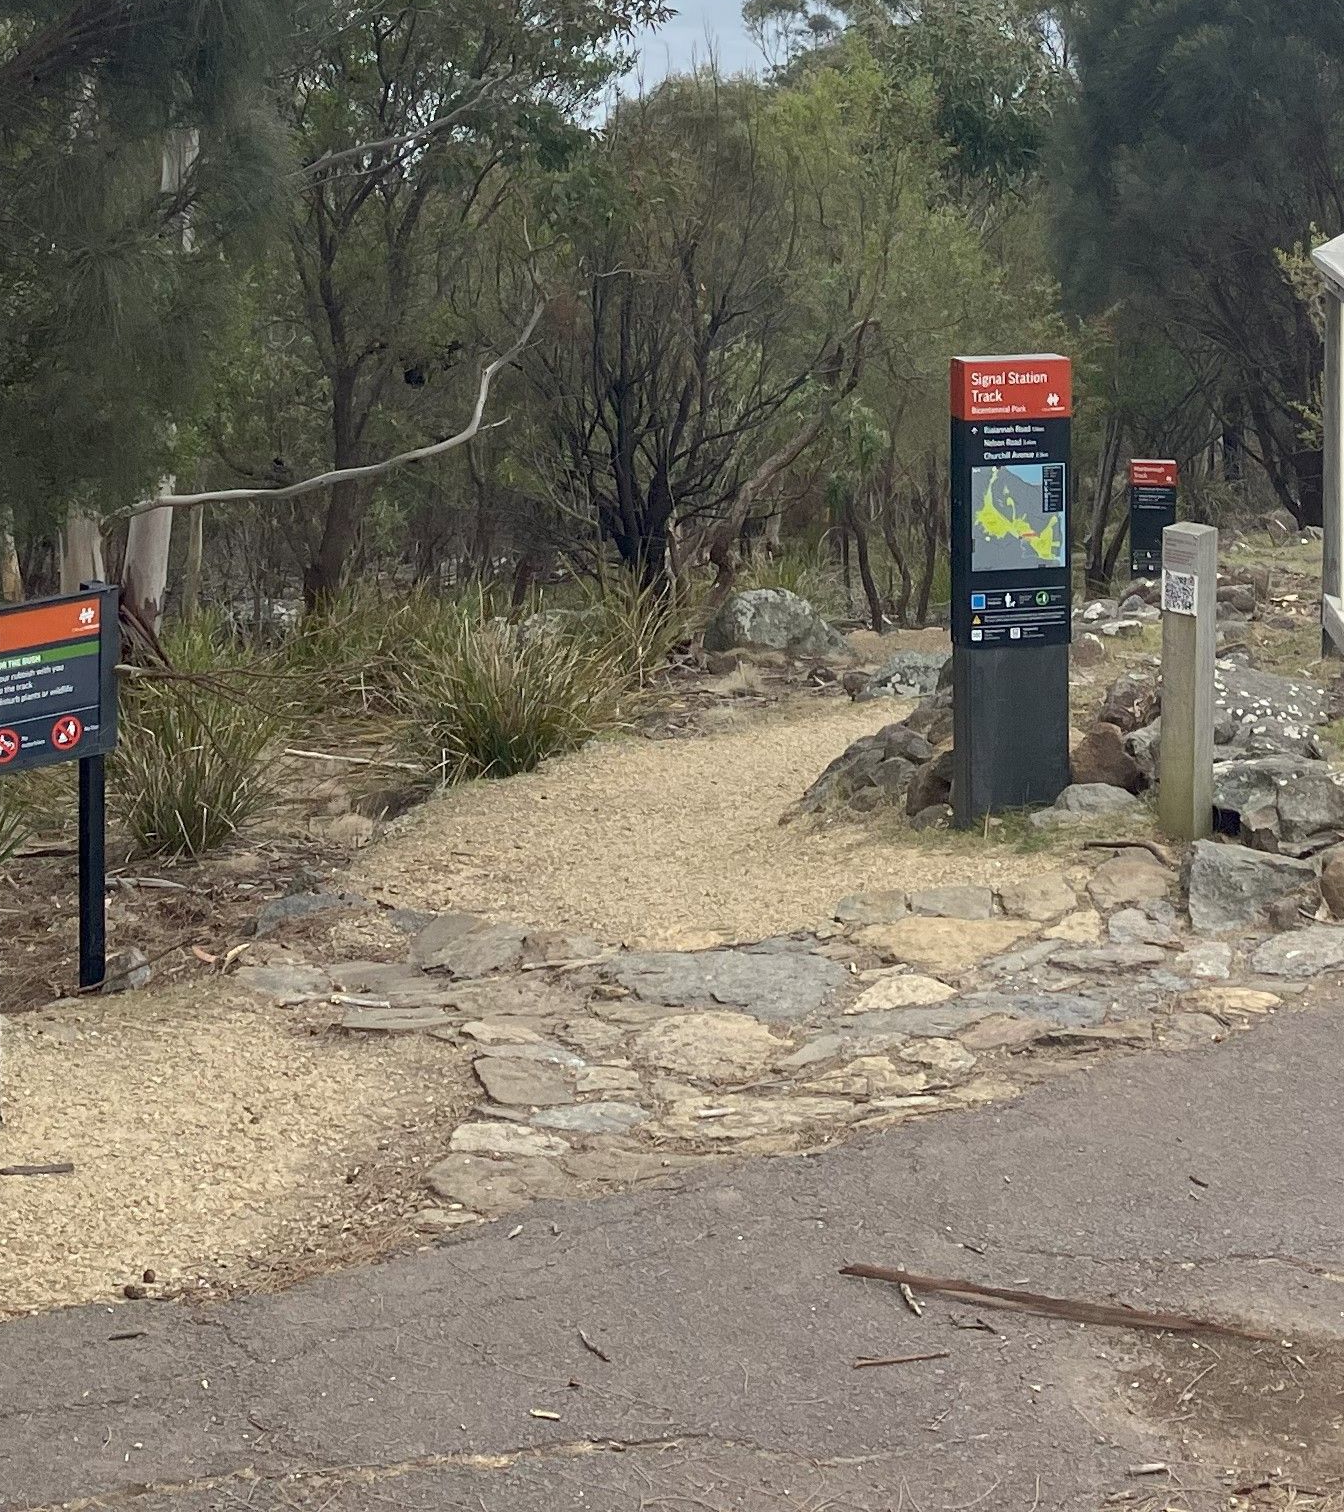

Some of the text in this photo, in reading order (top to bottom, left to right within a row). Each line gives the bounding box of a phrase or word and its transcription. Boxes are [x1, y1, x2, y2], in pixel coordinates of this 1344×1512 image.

[971, 370, 1047, 387] Signal Station
[971, 389, 1003, 403] Track
[1006, 438, 1022, 446] Road
[983, 451, 1011, 460] Churchill
[1012, 450, 1034, 459] Avenue
[8, 659, 21, 668] THE
[22, 654, 41, 665] BUSH
[11, 669, 35, 680] rubbish
[36, 665, 52, 676] with
[52, 664, 65, 674] you
[4, 685, 15, 694] the
[16, 681, 33, 691] track
[21, 691, 41, 703] plants
